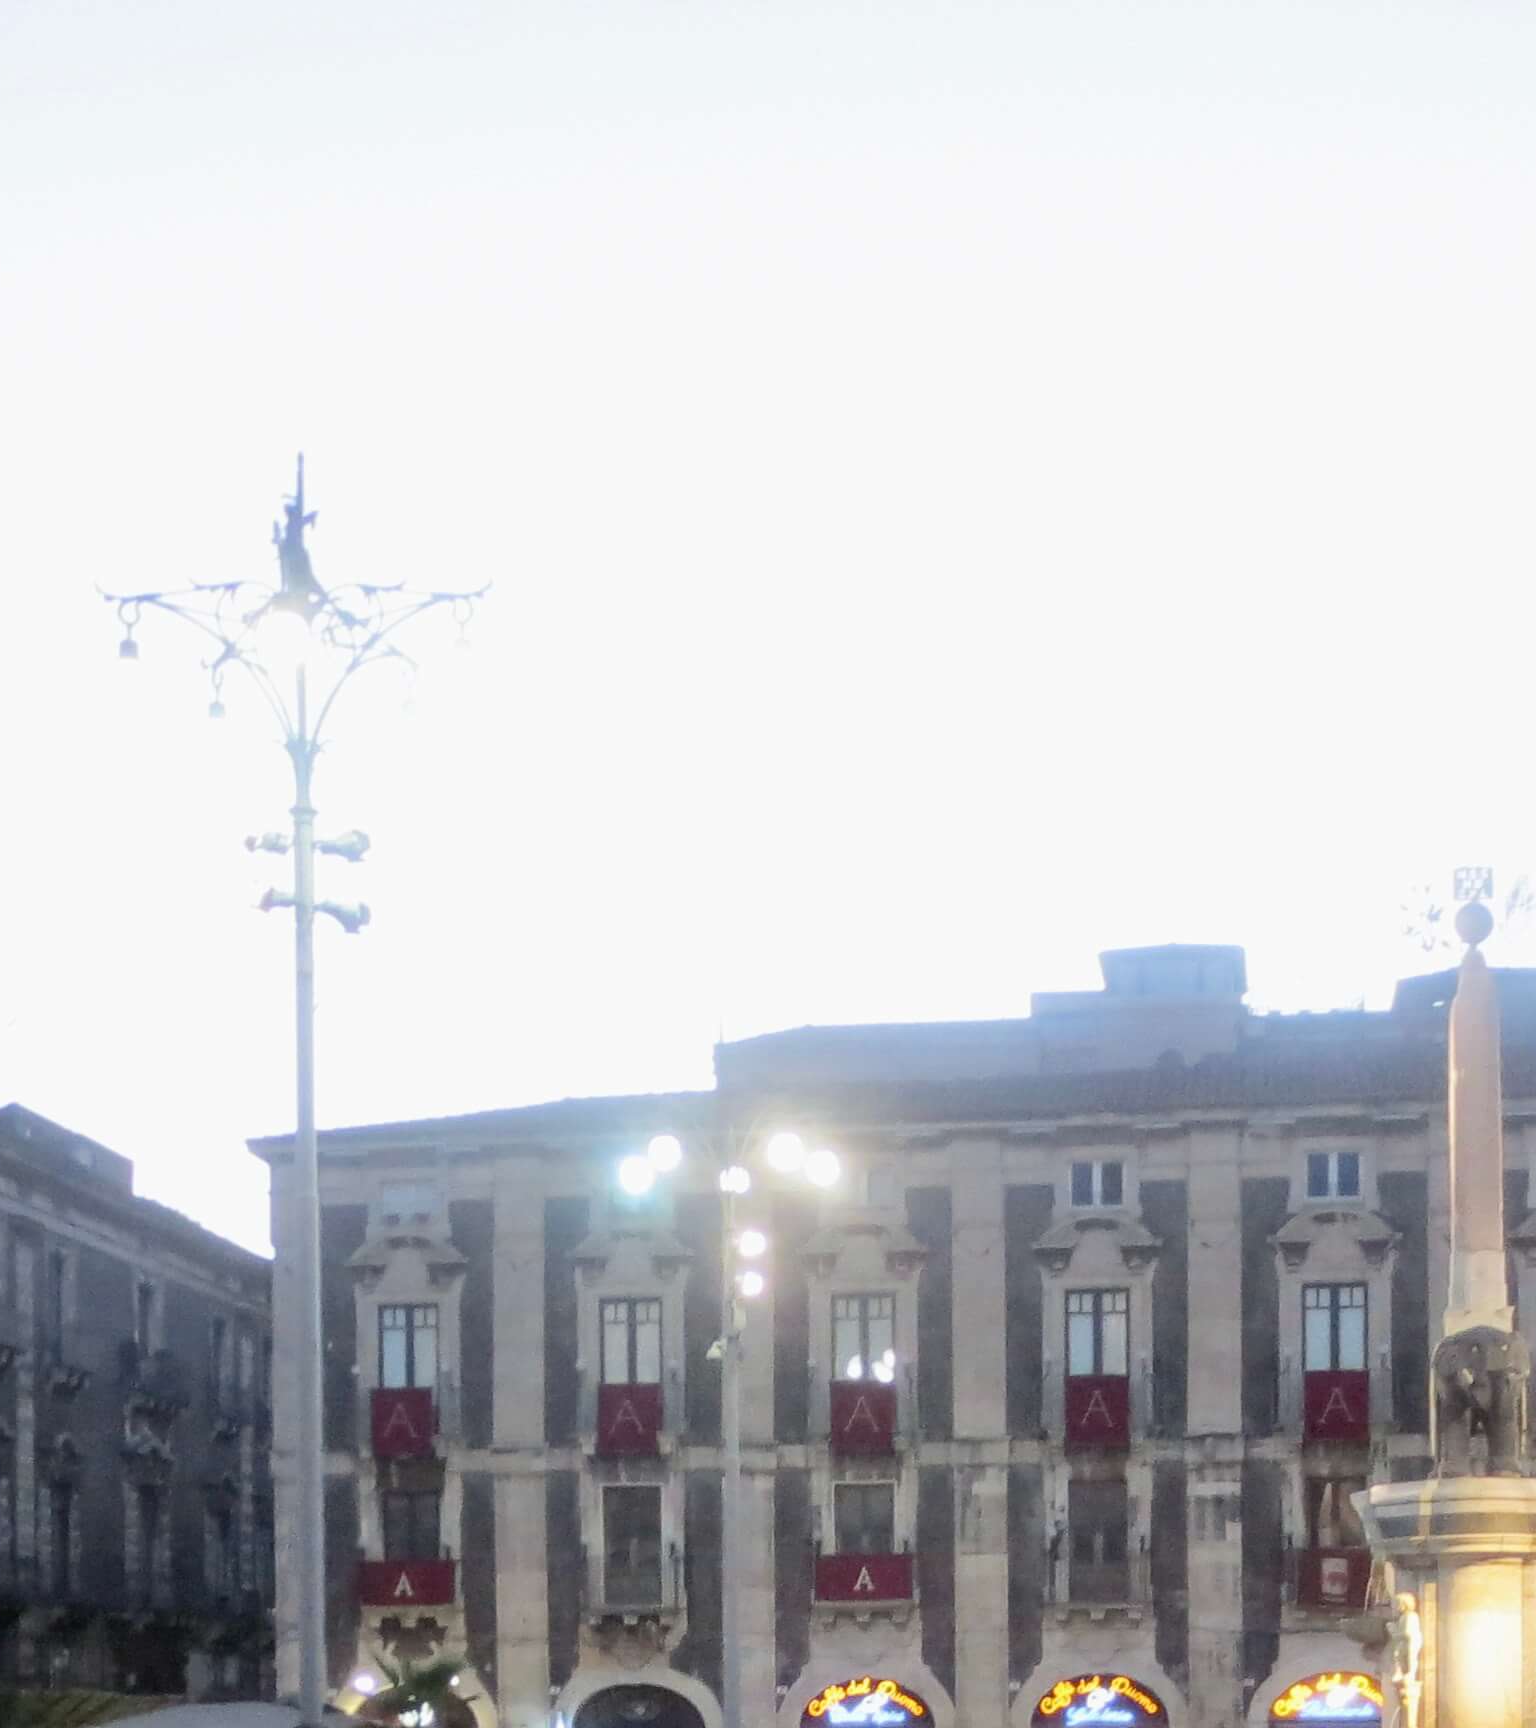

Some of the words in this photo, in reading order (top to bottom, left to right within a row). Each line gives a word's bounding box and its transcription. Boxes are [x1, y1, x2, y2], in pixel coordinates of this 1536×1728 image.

[383, 1402, 419, 1438] A
[610, 1399, 644, 1434] A
[844, 1396, 880, 1432] A
[1081, 1389, 1114, 1427] A
[1319, 1387, 1354, 1424] A
[393, 1570, 415, 1597] A
[853, 1566, 875, 1592] A
